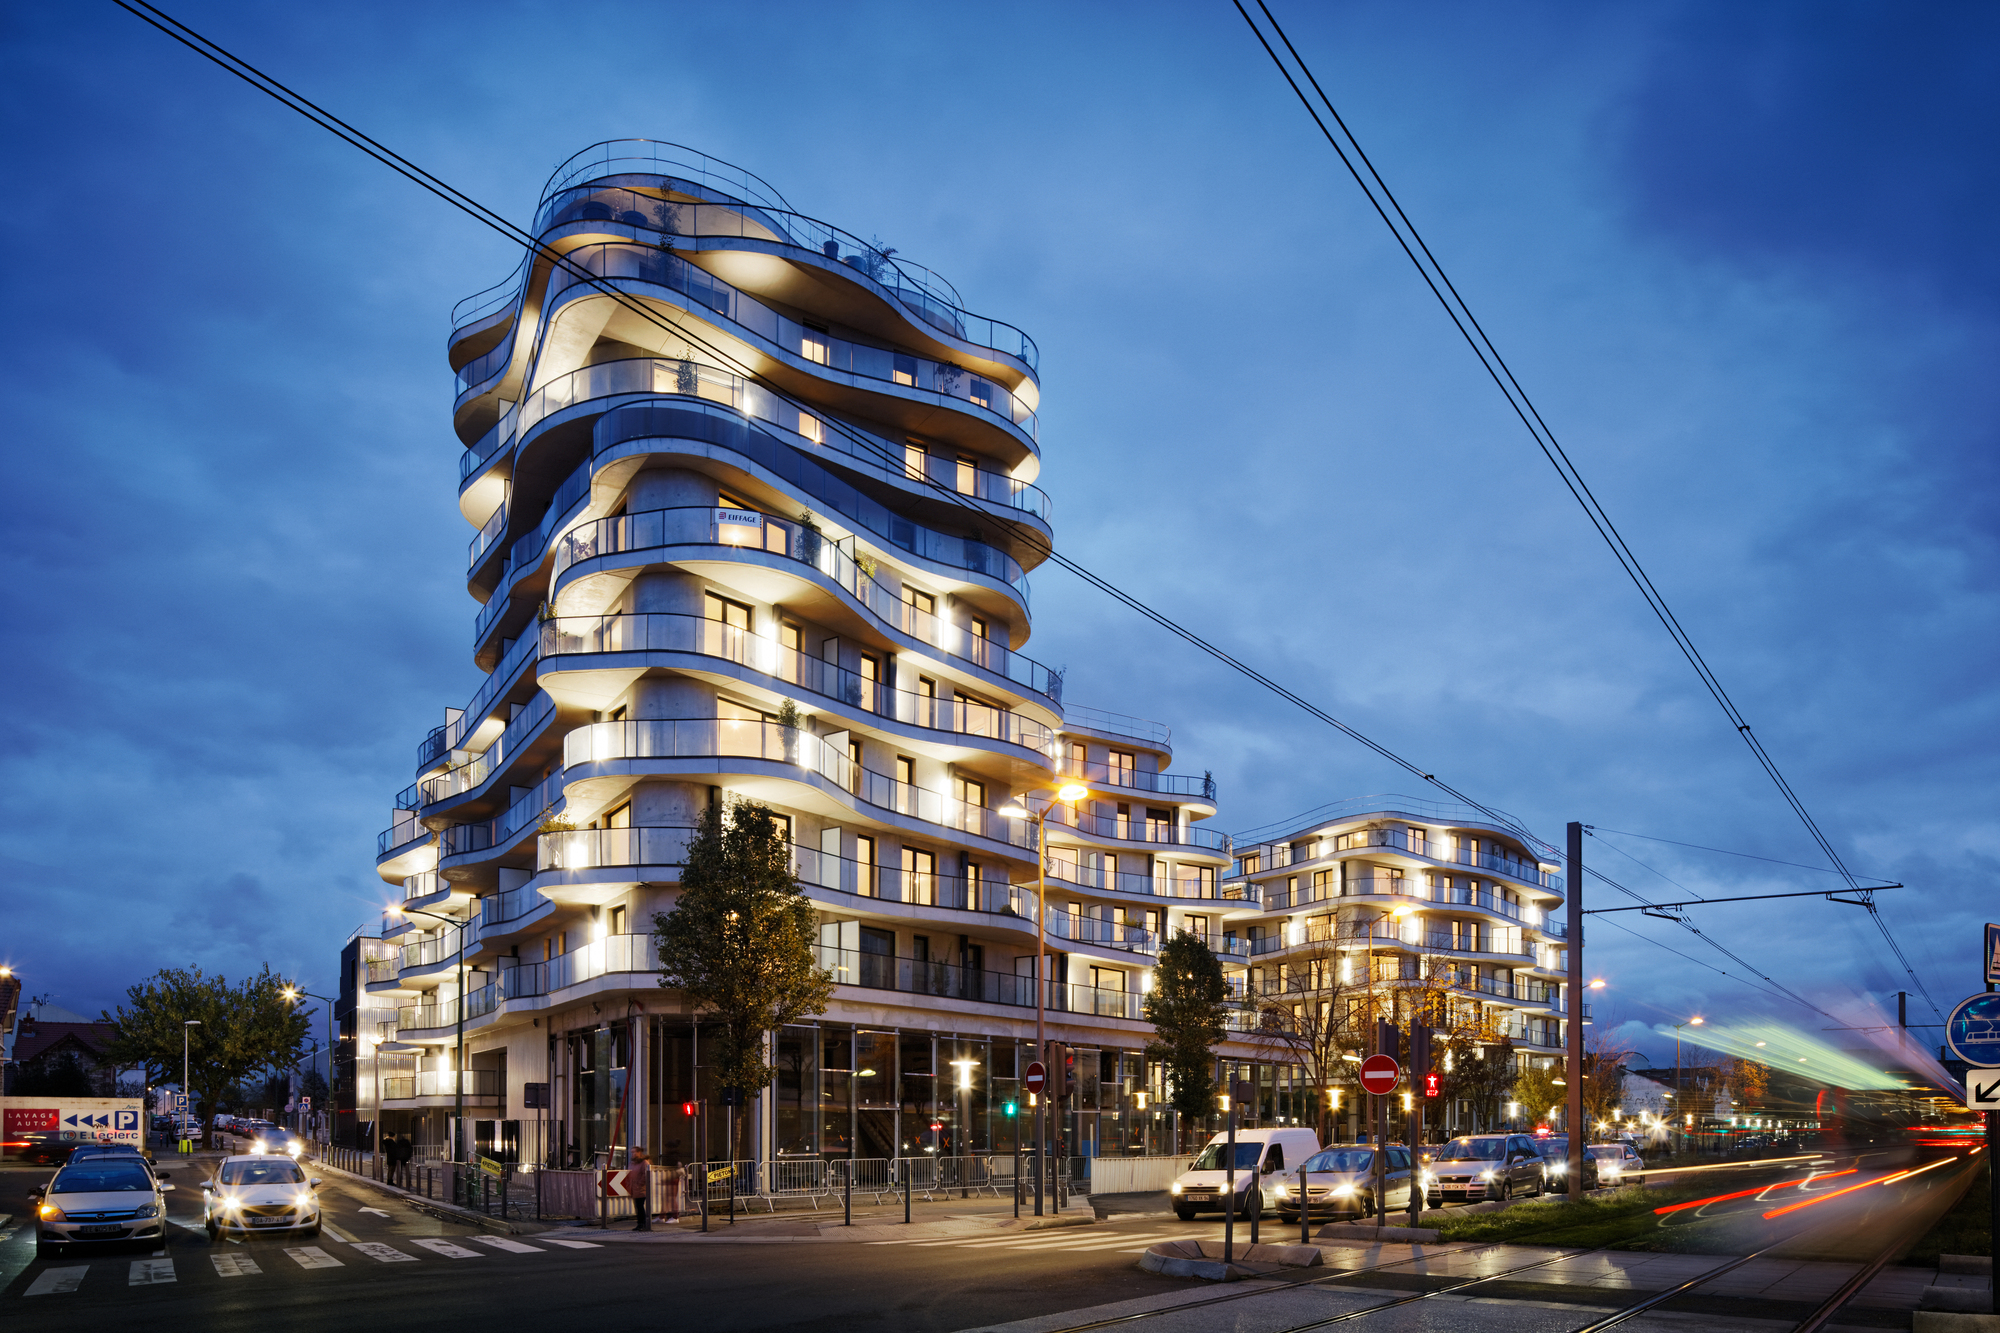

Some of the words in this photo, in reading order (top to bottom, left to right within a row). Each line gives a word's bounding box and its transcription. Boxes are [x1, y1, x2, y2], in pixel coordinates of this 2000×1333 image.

[728, 514, 757, 523] EIFFAGE
[118, 1112, 135, 1129] P
[80, 1131, 139, 1139] E.Leclerc
[484, 1161, 500, 1173] PIETONS
